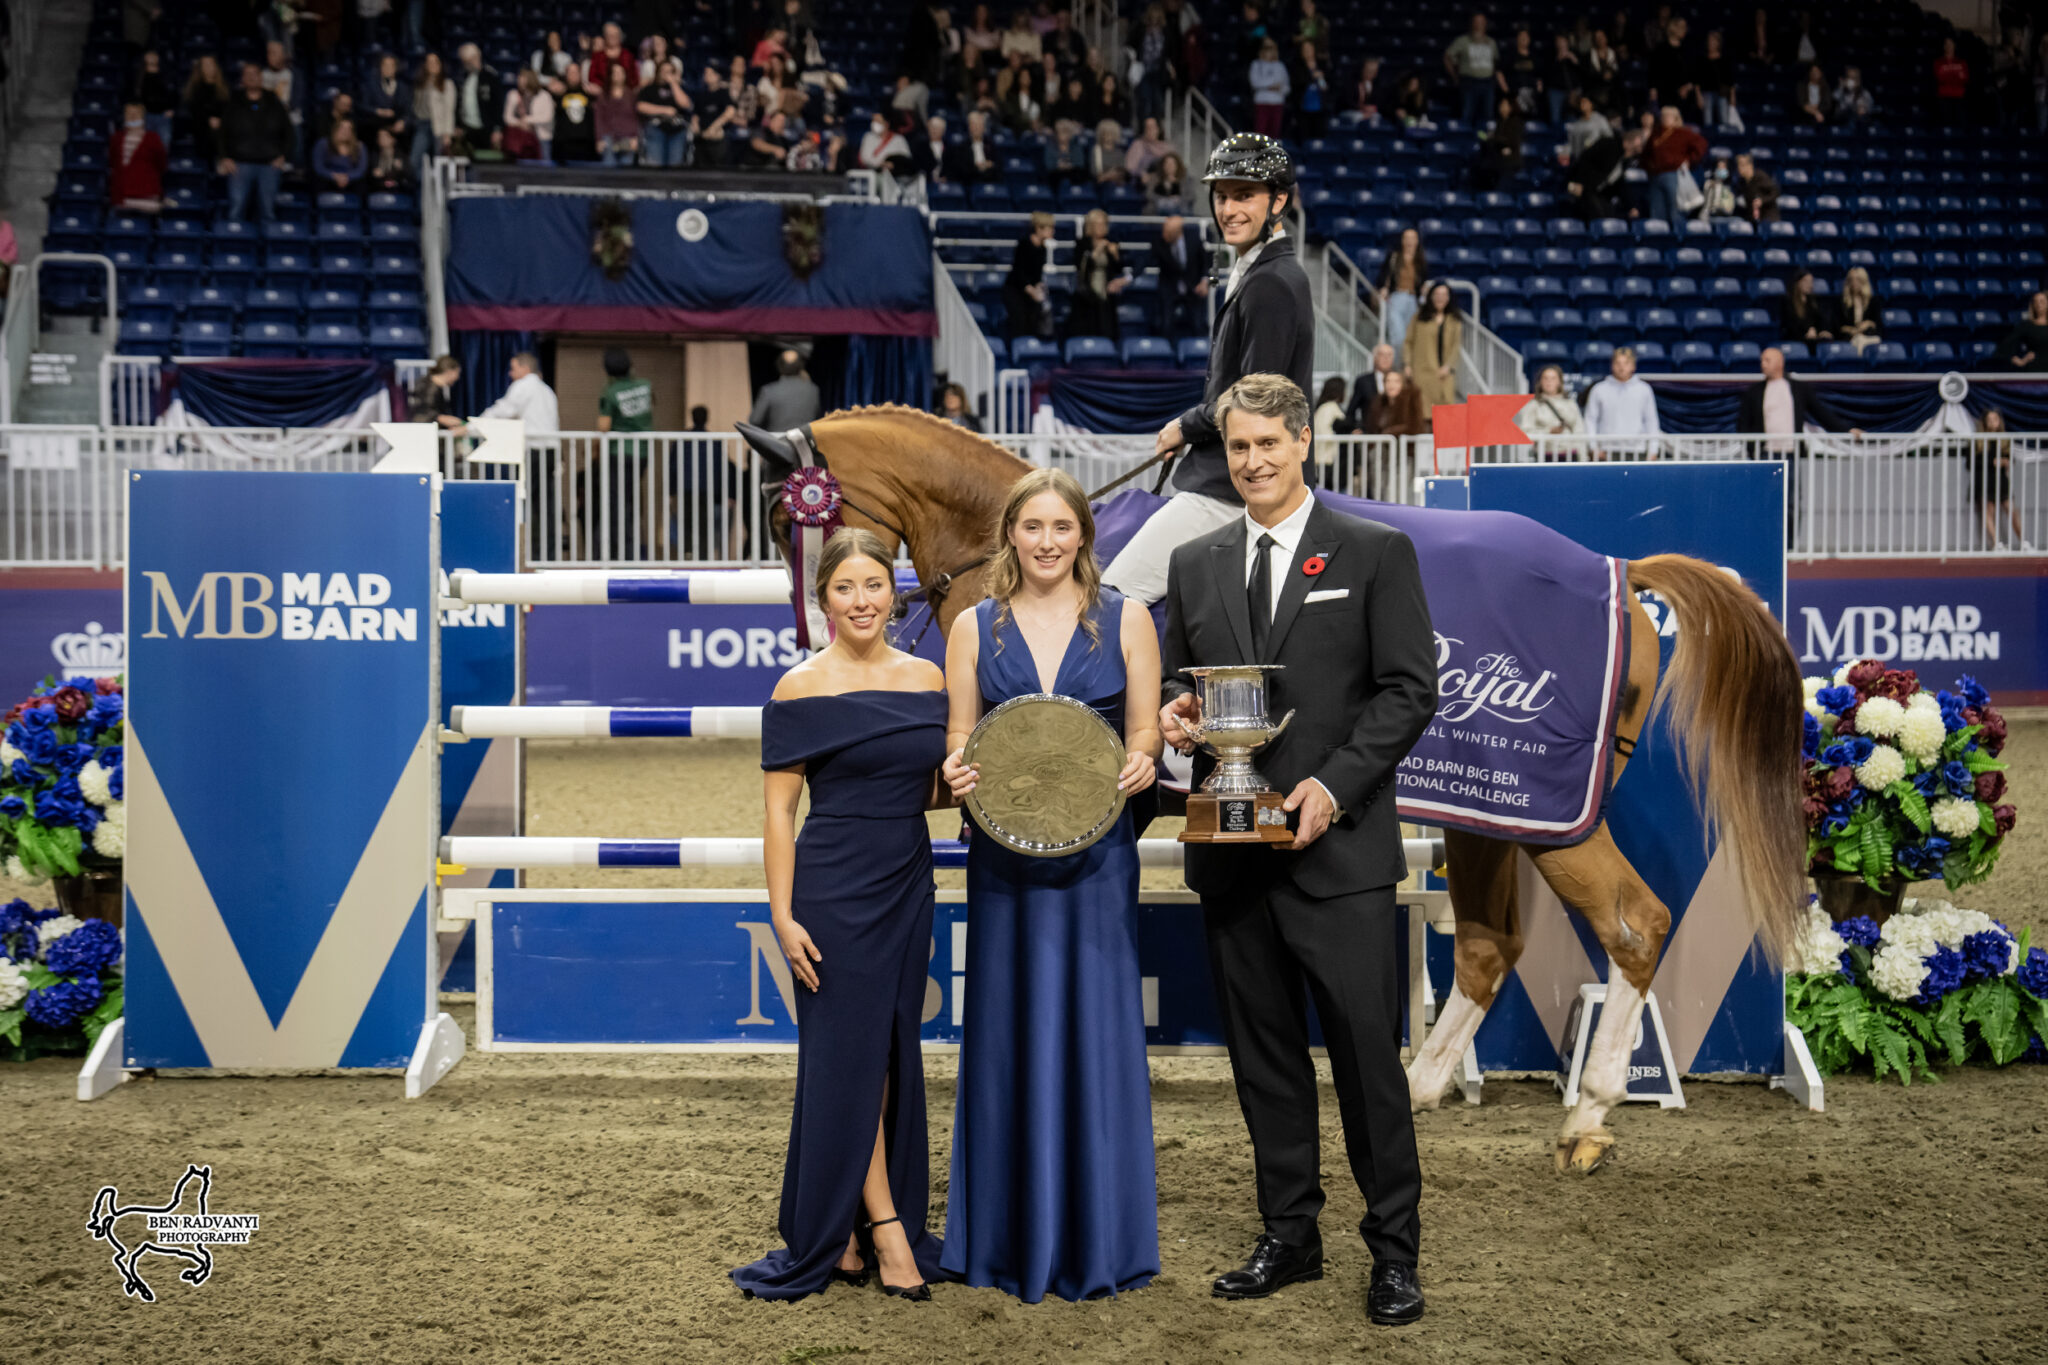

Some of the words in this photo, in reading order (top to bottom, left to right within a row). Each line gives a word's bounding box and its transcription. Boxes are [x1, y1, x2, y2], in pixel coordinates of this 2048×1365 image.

[283, 573, 391, 605] MAD
[142, 571, 278, 639] MB
[1901, 605, 1982, 633] MAD
[283, 608, 417, 641] BARN
[1800, 606, 1899, 662] MB
[668, 627, 815, 668] HORS
[1901, 632, 2000, 661] BARN
[1475, 653, 1523, 678] The
[1452, 728, 1508, 749] WINTER
[1513, 740, 1547, 755] FAIR
[1426, 759, 1464, 776] BARN
[1466, 765, 1489, 781] BIG
[1492, 771, 1519, 786] BEN
[1449, 781, 1530, 807] CHALLENGE
